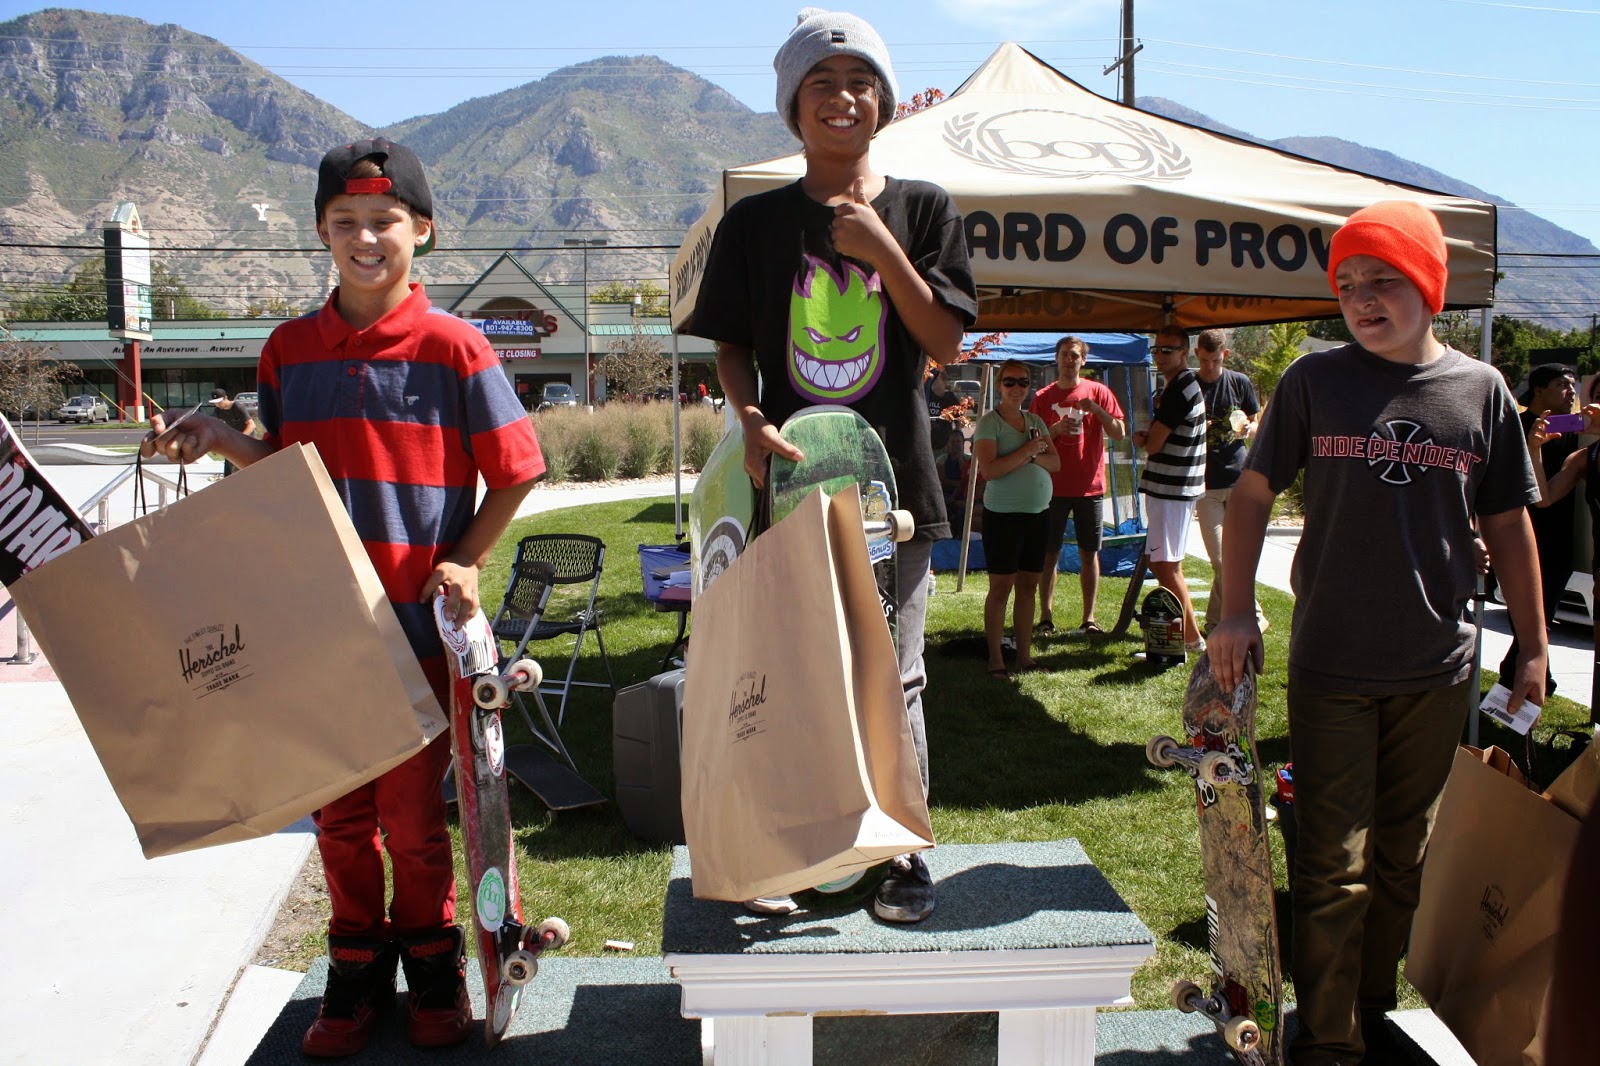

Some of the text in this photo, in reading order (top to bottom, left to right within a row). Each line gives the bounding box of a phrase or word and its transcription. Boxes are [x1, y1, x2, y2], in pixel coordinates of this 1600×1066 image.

[252, 203, 270, 221] Y
[1103, 212, 1179, 265] OF
[485, 324, 534, 332] 801-947-8300
[209, 345, 245, 353] ALWAYS!
[506, 350, 537, 358] CLOSING
[1312, 435, 1482, 474] INDEPENDENT
[178, 623, 246, 684] Herschel
[206, 672, 240, 691] TRADE MARK
[728, 673, 767, 727] Herschel
[331, 946, 375, 963] OSIRIS
